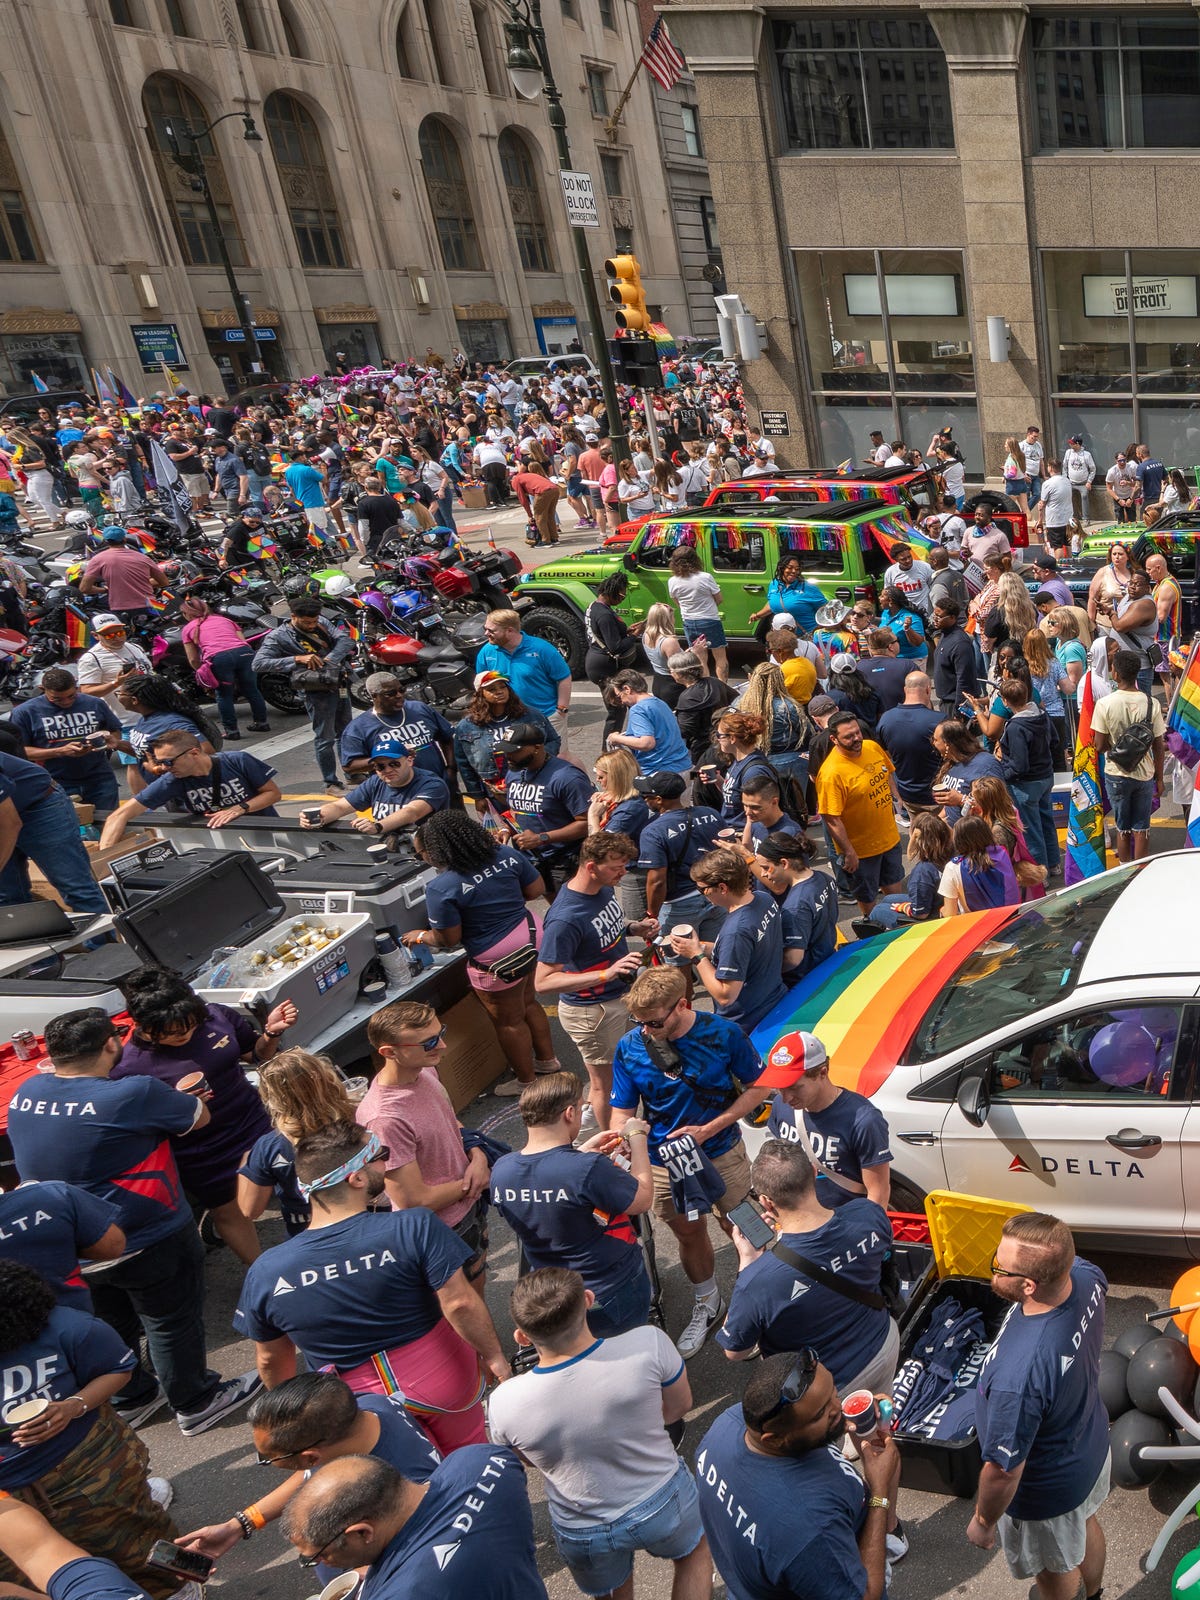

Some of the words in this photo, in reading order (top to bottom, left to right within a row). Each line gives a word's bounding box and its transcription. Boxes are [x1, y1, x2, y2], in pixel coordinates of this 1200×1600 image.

[562, 178, 575, 191] DO
[576, 178, 592, 192] NOT
[566, 196, 596, 210] BLOCK
[569, 212, 598, 222] INTERSECTION
[42, 710, 98, 732] PRIDE
[379, 720, 431, 744] PRIDE
[44, 728, 59, 738] IN
[869, 772, 885, 786] GOD
[508, 782, 544, 802] PRIDE
[472, 856, 518, 884] DELTA
[600, 934, 611, 948] IN
[312, 944, 346, 974] IGLOO
[20, 1098, 97, 1117] DELTA
[1042, 1156, 1145, 1178] DELTA
[505, 1188, 569, 1203] DELTA
[820, 1231, 880, 1274] ELTA
[300, 1248, 397, 1287] DELTA
[1072, 1283, 1103, 1351] DELTA
[452, 1455, 508, 1532] DELTA
[706, 1464, 758, 1546] DELTA
